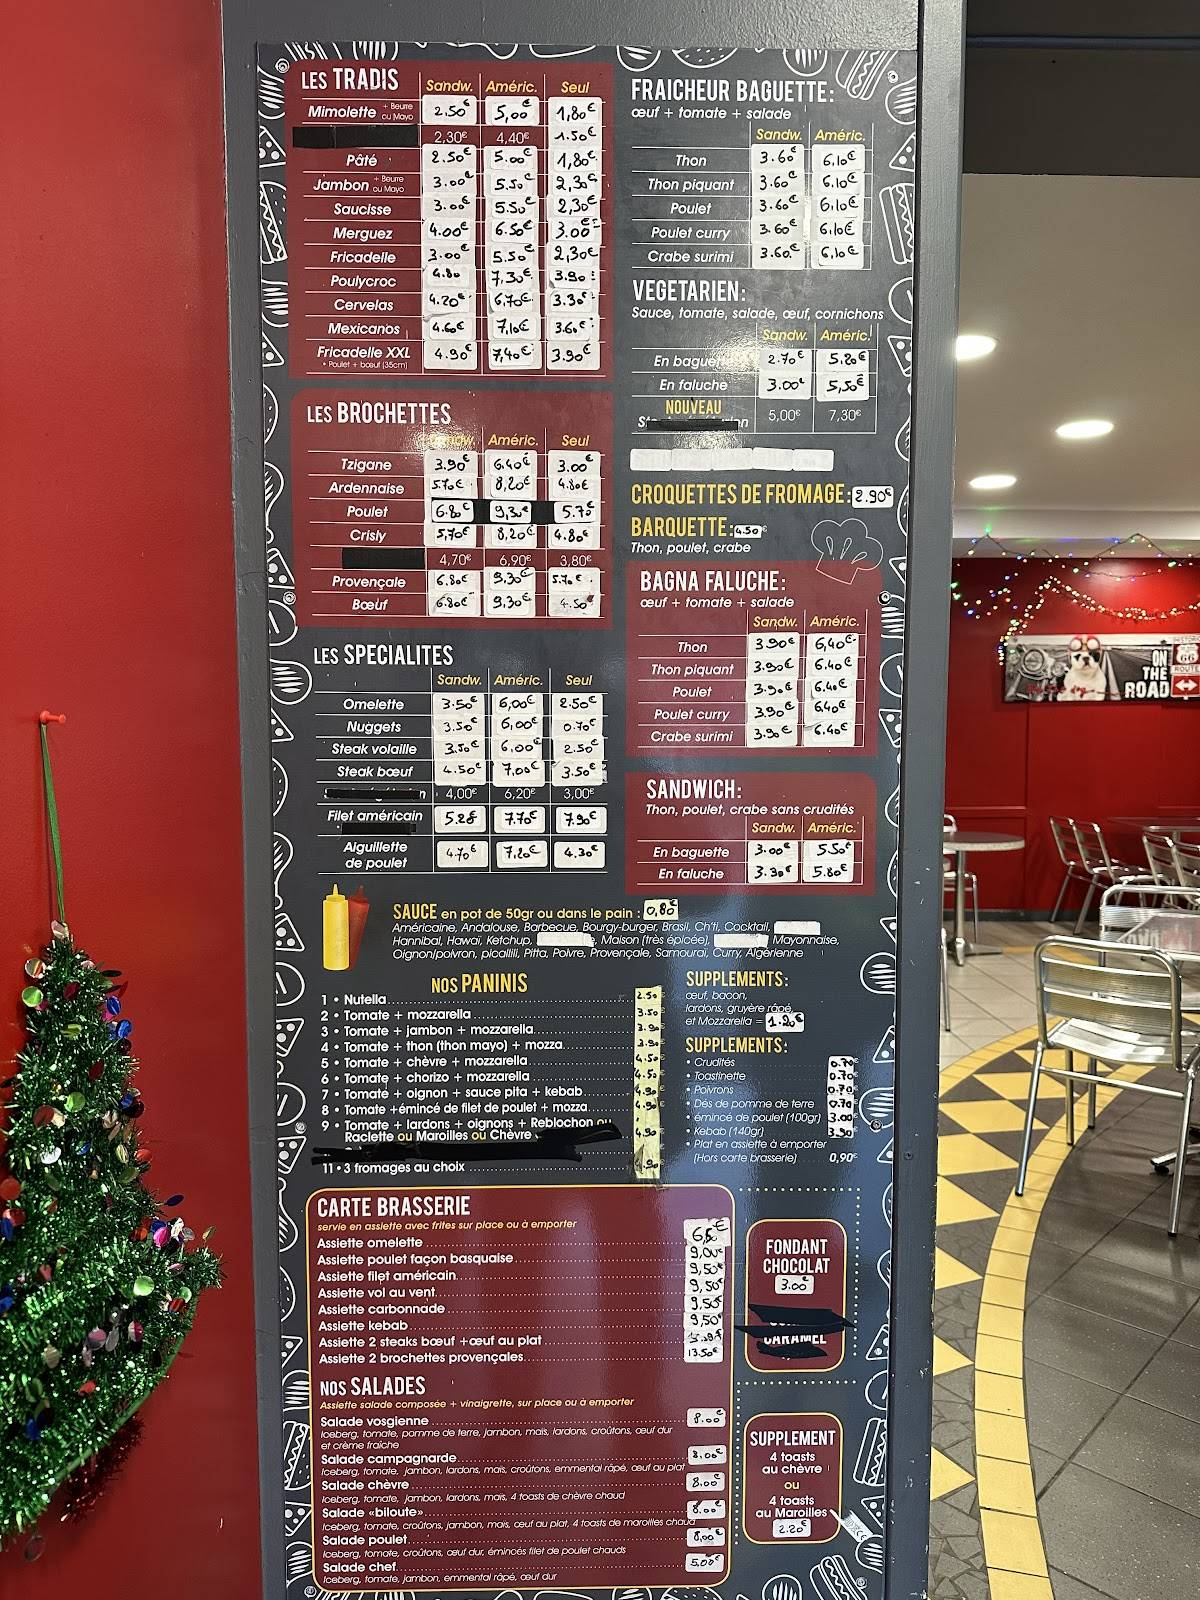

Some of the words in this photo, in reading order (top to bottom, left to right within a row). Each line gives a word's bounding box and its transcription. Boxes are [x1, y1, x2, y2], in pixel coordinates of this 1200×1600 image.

[302, 72, 327, 89] LES
[333, 68, 398, 90] TRADIS
[427, 80, 473, 93] Sandw.
[486, 80, 537, 93] Améric.
[561, 81, 589, 94] Seul
[632, 79, 729, 101] FRAICHEUR
[737, 80, 834, 102] BAGUETTE:
[309, 106, 376, 118] Mimolette
[434, 131, 468, 143] 2,30€
[497, 132, 530, 145] 4,40€
[346, 154, 377, 166] Pâté
[676, 155, 706, 166] Thon
[313, 179, 369, 191] Jambon
[334, 203, 392, 215] Saucisse
[333, 227, 393, 240] Merguez
[651, 228, 694, 239] Poulet
[697, 229, 730, 241] curry
[330, 252, 396, 263] Fricadelle
[648, 251, 691, 262] Crabe
[694, 251, 733, 263] surimi
[331, 276, 396, 288] Poulycroc
[633, 280, 745, 301] VEGETARIEN:
[334, 299, 393, 311] Cervelas
[632, 307, 675, 319] Sauce,
[679, 308, 728, 320] tomate,
[732, 309, 779, 320] salade,
[783, 309, 811, 321] œuf,
[815, 309, 884, 320] cornichons
[328, 323, 400, 334] Mexicanos
[317, 346, 384, 358] Fricadelle
[386, 347, 410, 359] XXL
[659, 380, 675, 391] En
[679, 380, 728, 391] faluche
[307, 406, 332, 423] LES
[338, 402, 450, 424] BROCHETTES
[666, 400, 721, 415] NOUVEAU
[769, 410, 800, 421] 5,00€
[341, 460, 391, 471] Tzigane
[329, 483, 404, 494] Ardennaise
[632, 484, 736, 504] CROQUETTES
[741, 484, 761, 504] DE
[350, 530, 386, 542] Crisly
[440, 554, 471, 565] 4,70€
[332, 577, 406, 590] Provençale
[641, 571, 699, 591] BAGNA
[352, 599, 388, 610] Bœuf
[314, 648, 338, 664] LES
[344, 644, 453, 665] SPECIALITES
[1153, 650, 1167, 667] ON
[1143, 666, 1167, 680] THE
[1125, 681, 1169, 698] ROAD
[344, 699, 404, 710] Omelette
[347, 722, 401, 734] Nuggets
[332, 744, 368, 754] Steak
[371, 743, 417, 754] volaille
[446, 789, 477, 799] 4,00€
[328, 810, 354, 822] Filet
[357, 810, 423, 822] américain
[646, 804, 678, 815] Thon,
[682, 805, 725, 816] poulet,
[730, 805, 768, 815] crabe
[771, 806, 799, 815] sans
[803, 804, 854, 815] crudités
[344, 842, 407, 854] Aiguillette
[346, 858, 362, 868] de
[364, 858, 407, 870] poulet
[393, 904, 437, 920] SAUCE
[441, 910, 457, 919] en
[461, 910, 482, 921] pot
[486, 908, 502, 919] de
[506, 908, 534, 921] 50gr
[537, 910, 553, 919] ou
[557, 908, 587, 918] dans
[591, 908, 602, 918] le
[606, 909, 632, 920] pain
[392, 923, 458, 933] Américaine,
[461, 922, 520, 932] Andalouse,
[582, 922, 658, 932] Bourgy-burger,
[662, 922, 690, 932] Brasil,
[725, 922, 770, 932] Cocktail,
[432, 978, 457, 993] NOS
[462, 973, 528, 993] PANINIS
[712, 991, 747, 1000] bacon,
[321, 1058, 329, 1068] 5
[345, 1057, 389, 1068] Tomate
[394, 1059, 402, 1067] +
[406, 1056, 447, 1067] chèvre
[451, 1058, 460, 1067] +
[464, 1055, 528, 1066] mozzarella
[695, 1058, 735, 1067] Crudités
[695, 1072, 746, 1080] Toastinette
[694, 1127, 726, 1136] Kebab
[729, 1127, 764, 1136] (140gr)
[323, 1163, 334, 1173] 11
[344, 1163, 350, 1173] 3
[354, 1162, 411, 1175] fromages
[415, 1164, 429, 1172] au
[433, 1162, 464, 1172] choix
[318, 1198, 372, 1218] CARTE
[377, 1196, 470, 1216] BRASSERIE
[318, 1237, 364, 1249] Assiette
[367, 1236, 423, 1248] omelette
[766, 1239, 828, 1255] FONDANT
[763, 1258, 830, 1274] CHOCOLAT
[320, 1380, 346, 1396] NOS
[351, 1376, 425, 1395] SALADES
[321, 1416, 363, 1428] Salade
[366, 1415, 429, 1428] vosgienne
[750, 1430, 835, 1446] SUPPLEMENT
[770, 1452, 778, 1461] 4
[781, 1452, 815, 1462] toasts
[762, 1465, 778, 1473] au
[781, 1463, 822, 1474] chèvre
[322, 1508, 365, 1518] Salade
[369, 1507, 423, 1518] «biloute»
